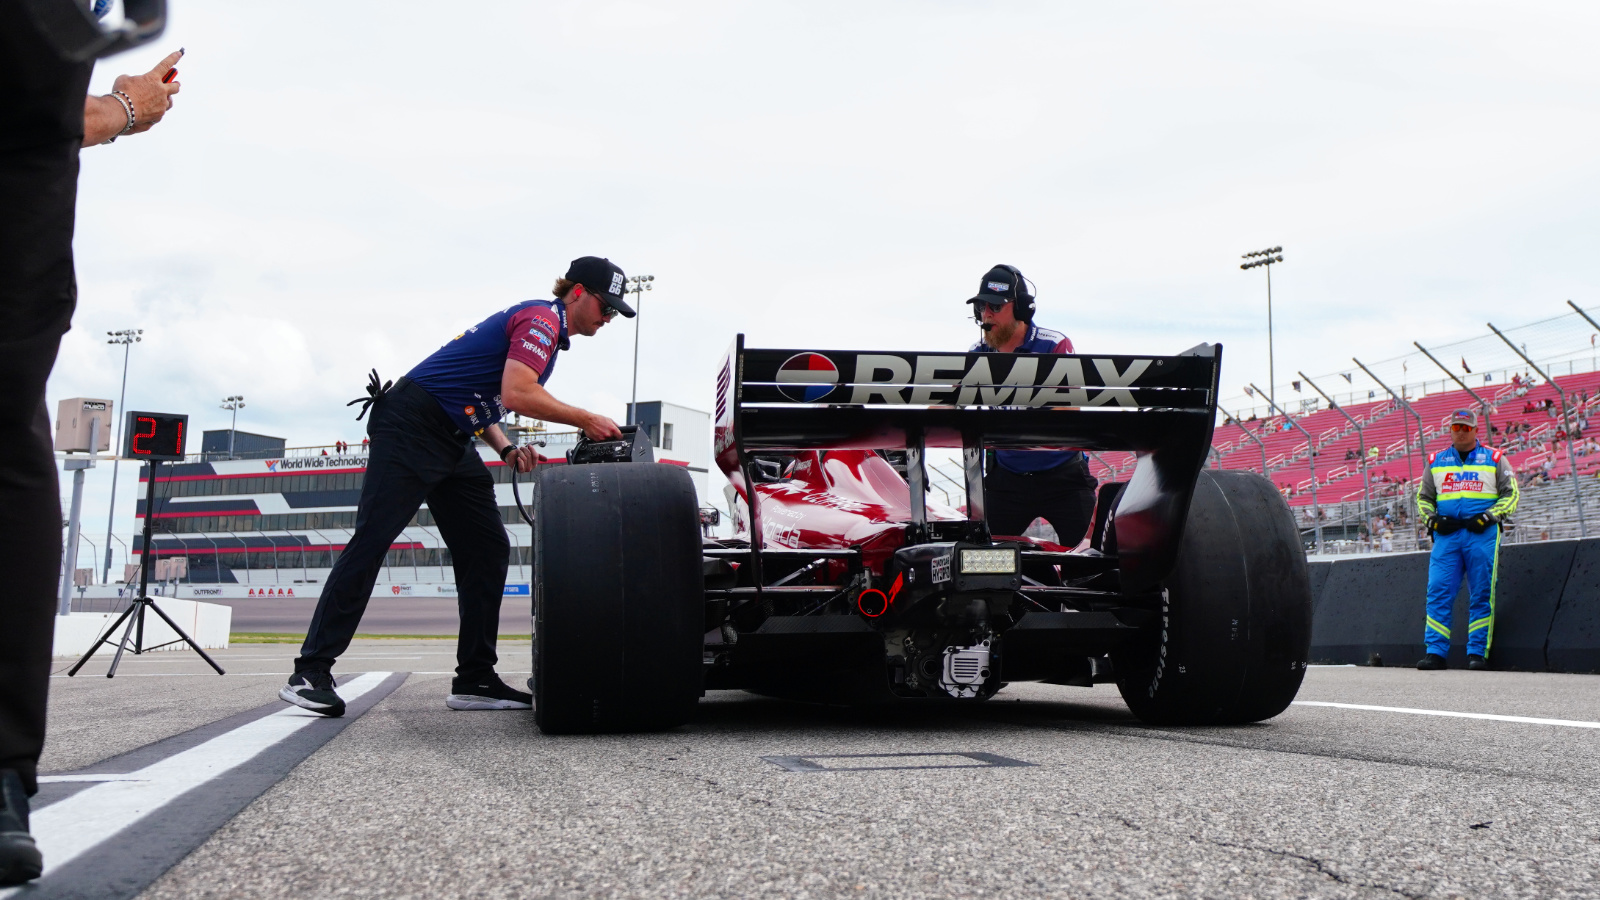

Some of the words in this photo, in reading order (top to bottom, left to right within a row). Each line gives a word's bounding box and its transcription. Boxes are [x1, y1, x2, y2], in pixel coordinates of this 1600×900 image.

[523, 341, 548, 361] REMAX
[850, 354, 1153, 407] REMAX
[133, 417, 182, 455] 21
[280, 459, 302, 469] World
[304, 458, 324, 468] Wide
[1444, 471, 1479, 482] AMR
